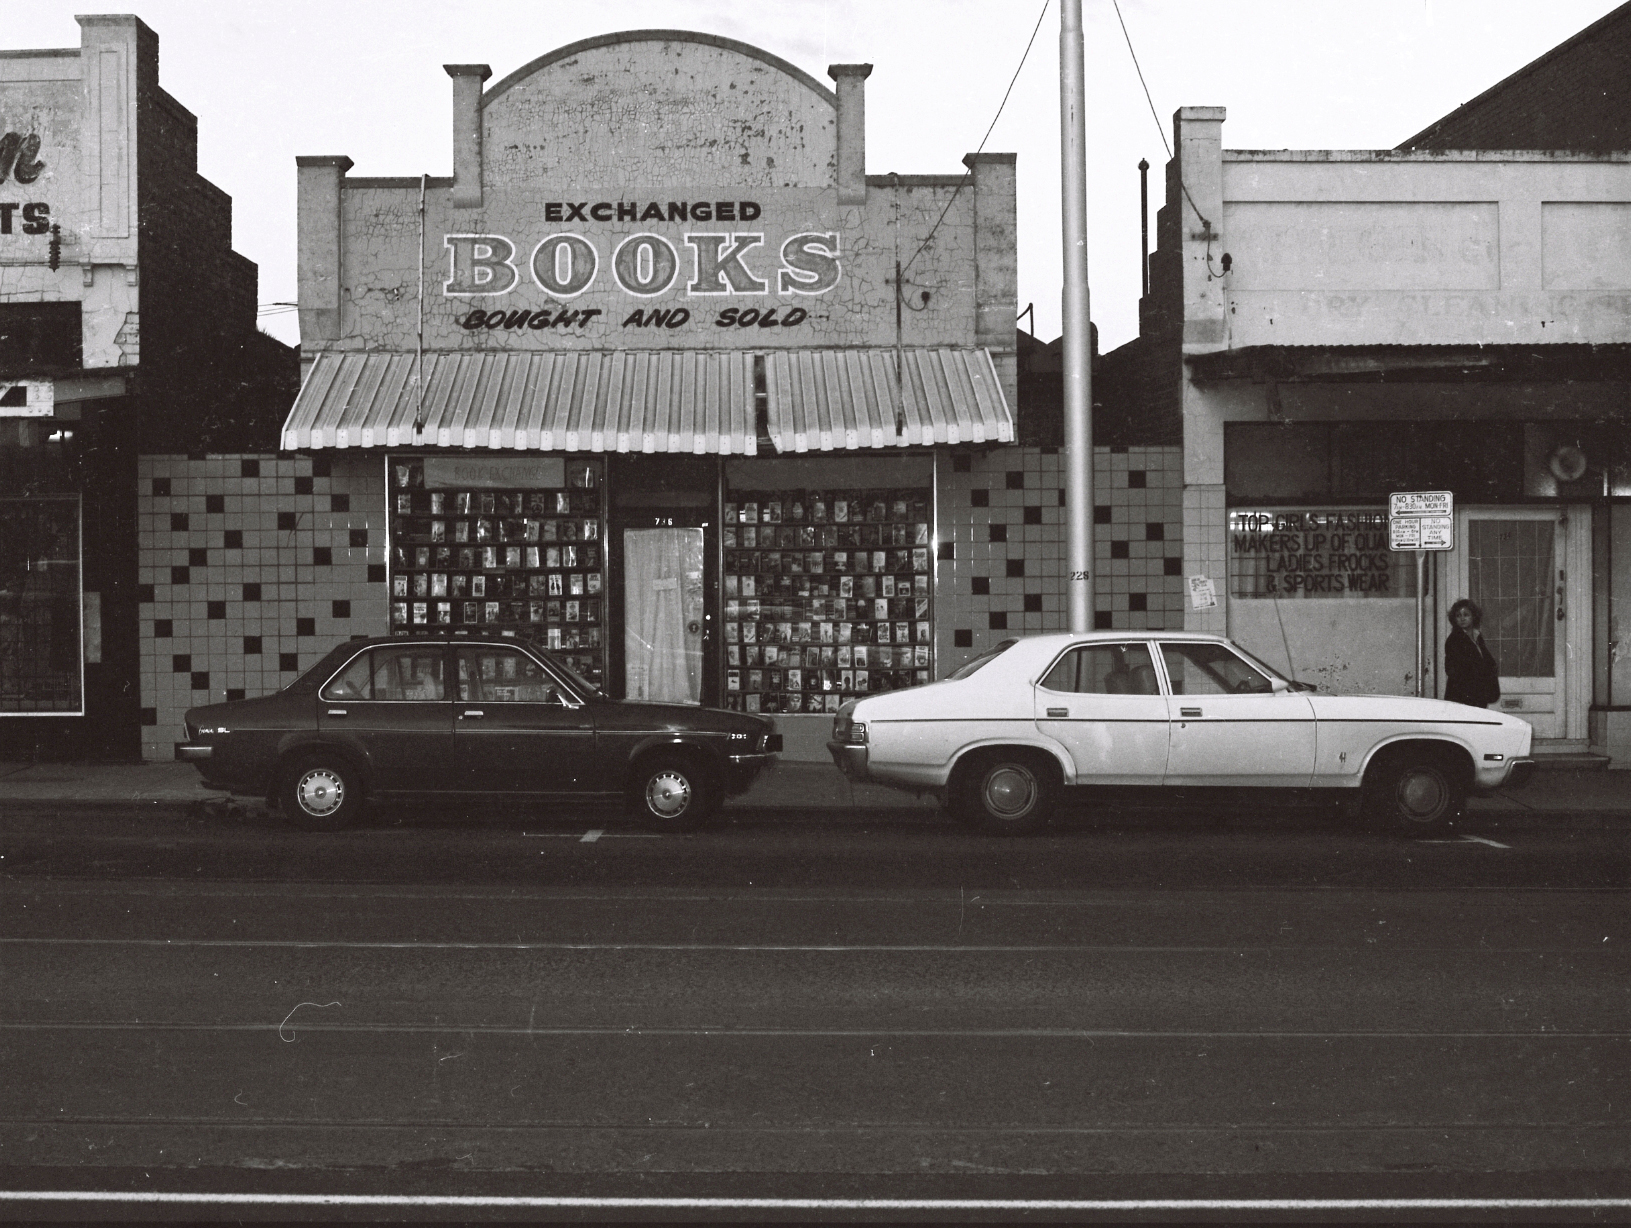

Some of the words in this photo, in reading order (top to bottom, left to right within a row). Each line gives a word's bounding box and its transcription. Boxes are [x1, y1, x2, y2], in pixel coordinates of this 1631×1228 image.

[544, 201, 762, 222] EXCHANGED
[443, 232, 841, 298] BOOKS
[462, 308, 602, 330] BOUGHT
[622, 308, 690, 329] AND
[715, 307, 808, 328] SOLD
[1396, 495, 1407, 503] NO
[1410, 494, 1446, 503] STANDING
[1237, 514, 1270, 532] TOP
[1275, 513, 1319, 533] GIRLS
[1234, 533, 1300, 553] MAKERS
[1304, 533, 1327, 552] UP
[1330, 533, 1352, 552] OF
[1266, 553, 1324, 573] LADIES
[1328, 552, 1389, 573] FROCKS
[1265, 574, 1277, 593] &
[1283, 573, 1346, 593] SPORTS
[1346, 573, 1389, 592] WEAR
